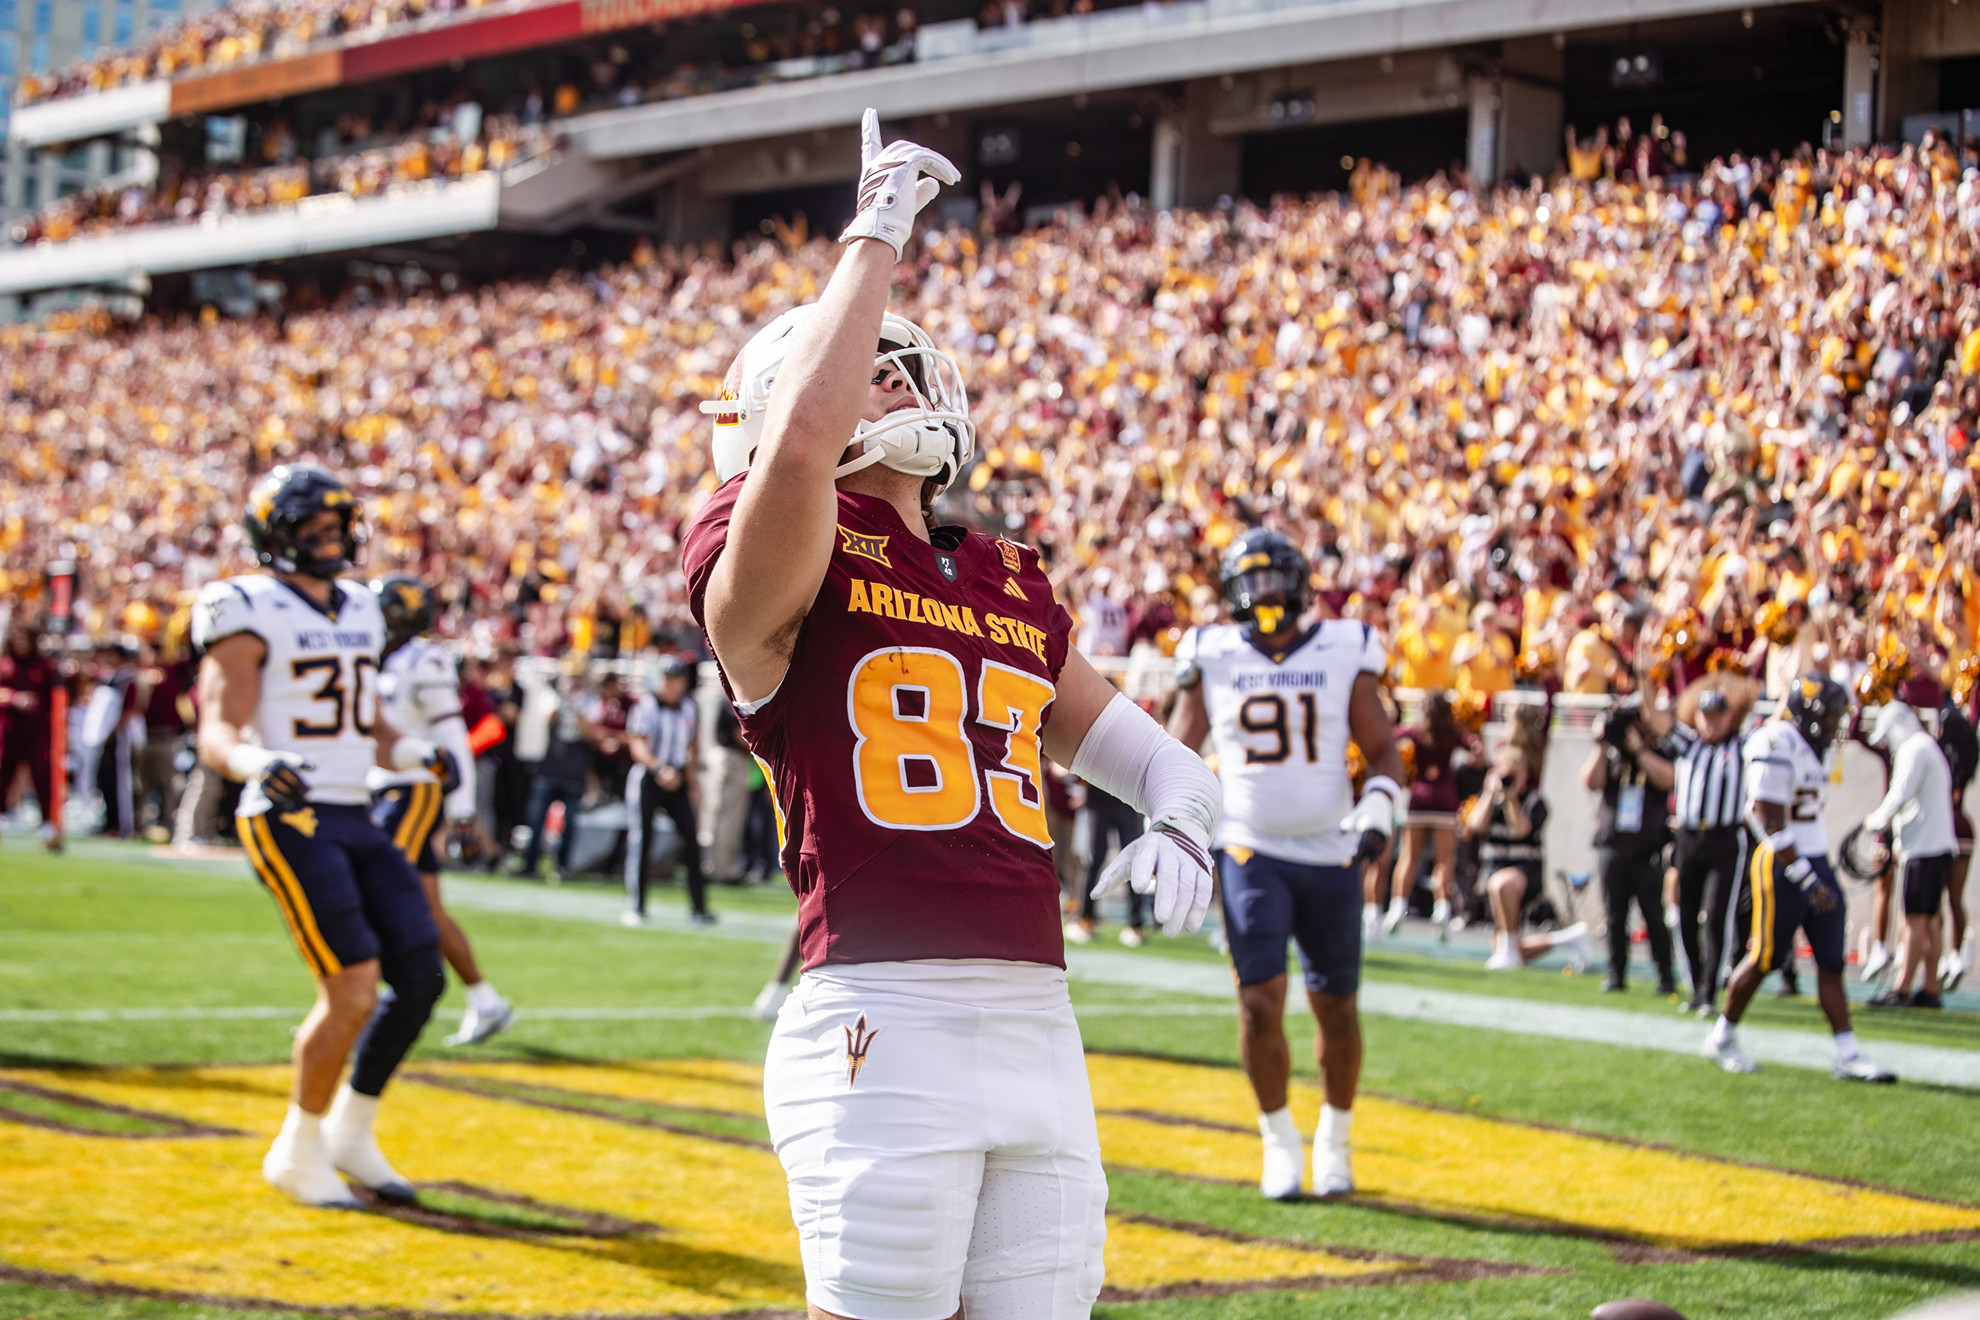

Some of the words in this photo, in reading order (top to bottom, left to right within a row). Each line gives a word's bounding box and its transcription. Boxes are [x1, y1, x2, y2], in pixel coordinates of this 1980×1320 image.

[837, 524, 892, 568] XII
[944, 568, 953, 576] 42
[848, 578, 985, 638] ARIZONA
[985, 613, 1048, 667] STATE
[291, 655, 381, 738] 30
[1239, 693, 1318, 765] 91
[847, 646, 1056, 850] 83
